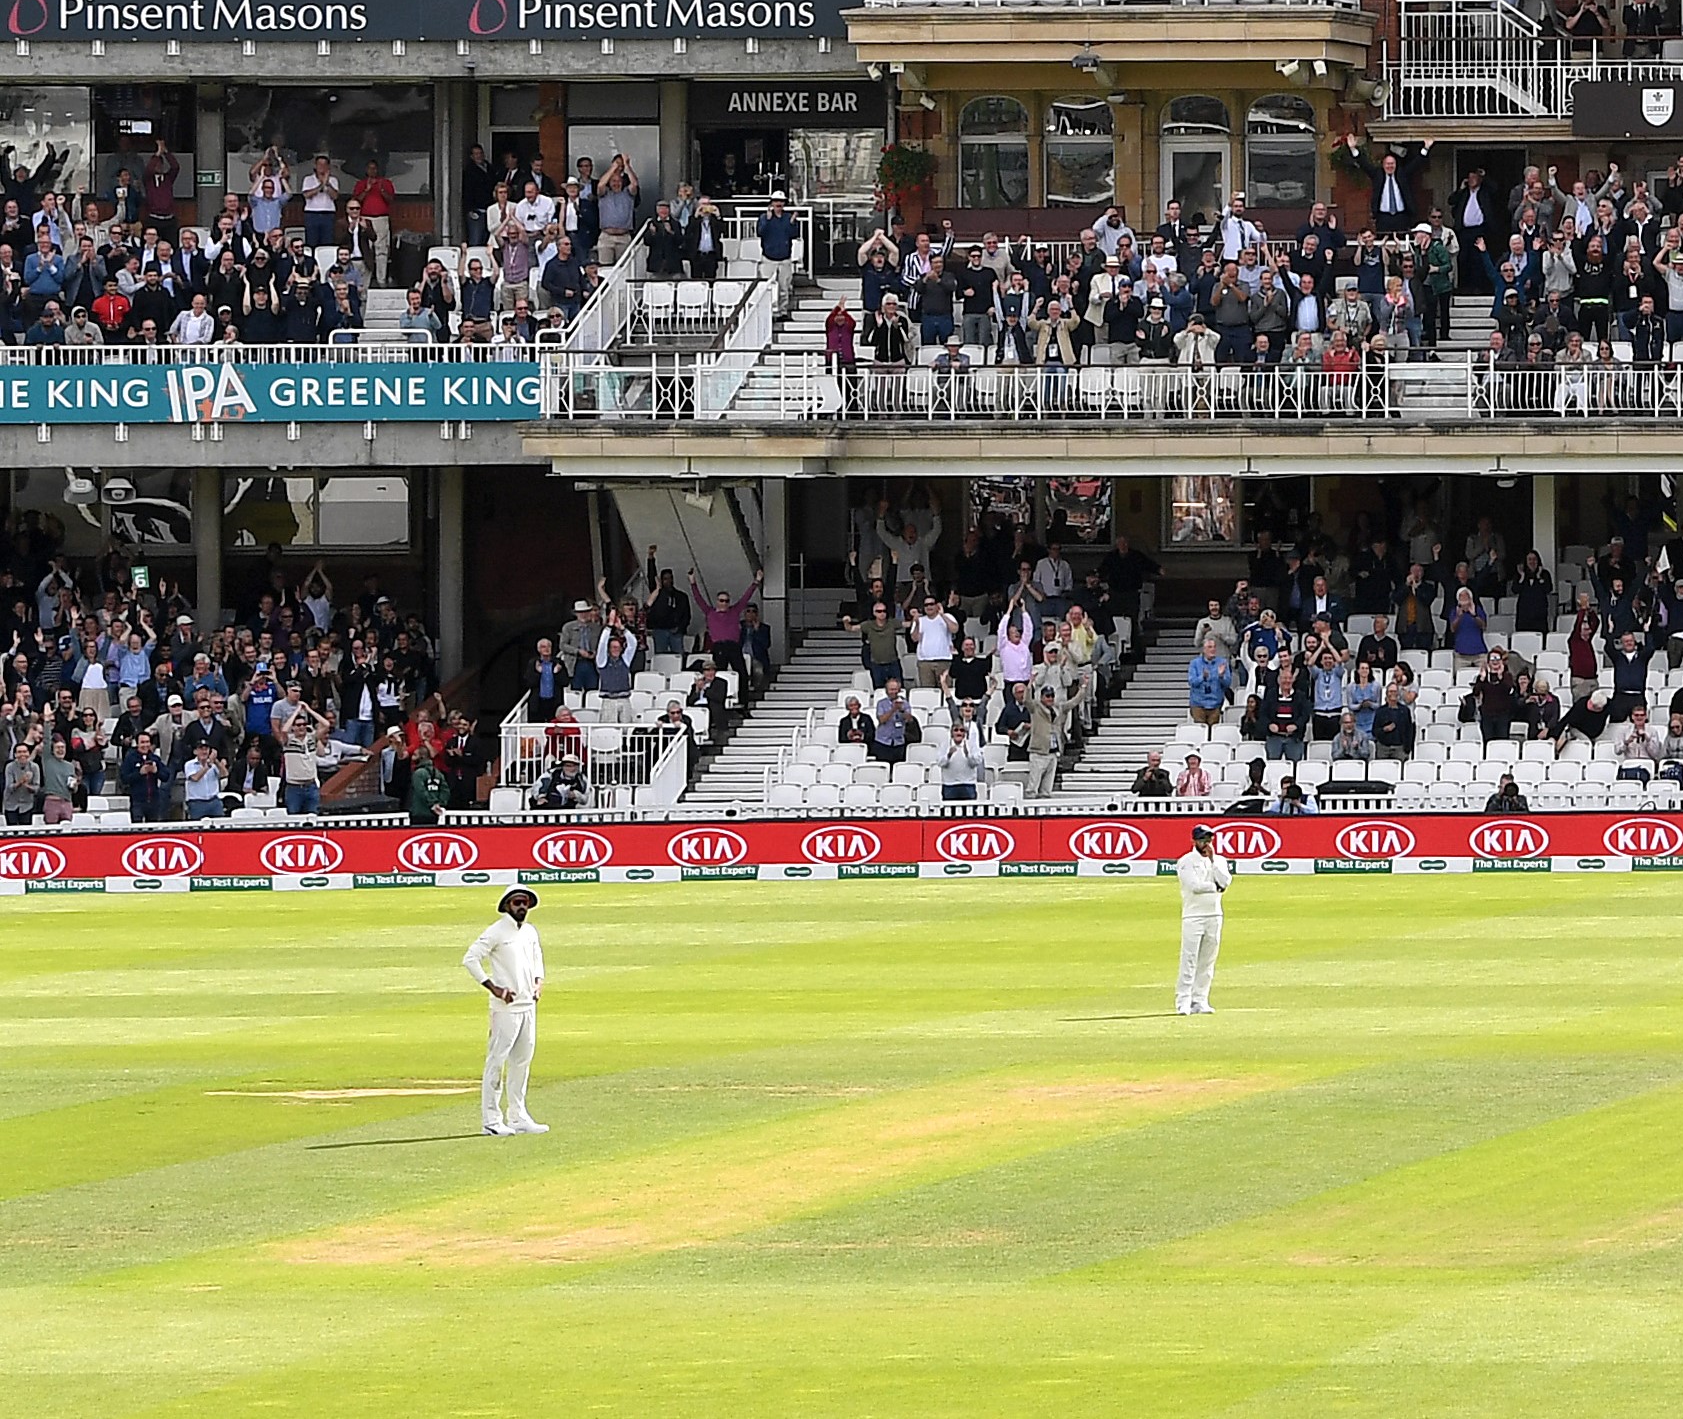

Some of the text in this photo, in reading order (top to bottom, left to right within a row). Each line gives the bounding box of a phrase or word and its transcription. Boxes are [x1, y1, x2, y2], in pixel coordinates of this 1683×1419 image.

[729, 93, 857, 111] ANNEXE BAR
[48, 380, 148, 407] KING
[167, 363, 257, 422] IPA
[270, 378, 425, 406] GREENE
[444, 377, 540, 405] KING
[135, 574, 145, 587] 6
[682, 838, 733, 859] KIA
[816, 835, 867, 857] KIA
[950, 834, 1000, 855] KIA
[1084, 832, 1134, 854] KIA
[1216, 832, 1267, 853] KIA
[1350, 831, 1401, 852] KIA
[1484, 830, 1535, 851] KIA
[1618, 828, 1669, 850] KIA
[136, 847, 188, 869] KIA
[275, 844, 329, 866] KIA
[412, 843, 464, 864] KIA
[547, 840, 598, 862] KIA
[0, 852, 52, 874] KIA
[683, 867, 756, 876] The Test Experts
[840, 865, 916, 875] The Test Experts
[1316, 860, 1390, 869] The Test Experts
[1475, 860, 1549, 869] The Test Experts
[27, 880, 103, 889] The Test Experts
[355, 875, 433, 884] The Test Experts
